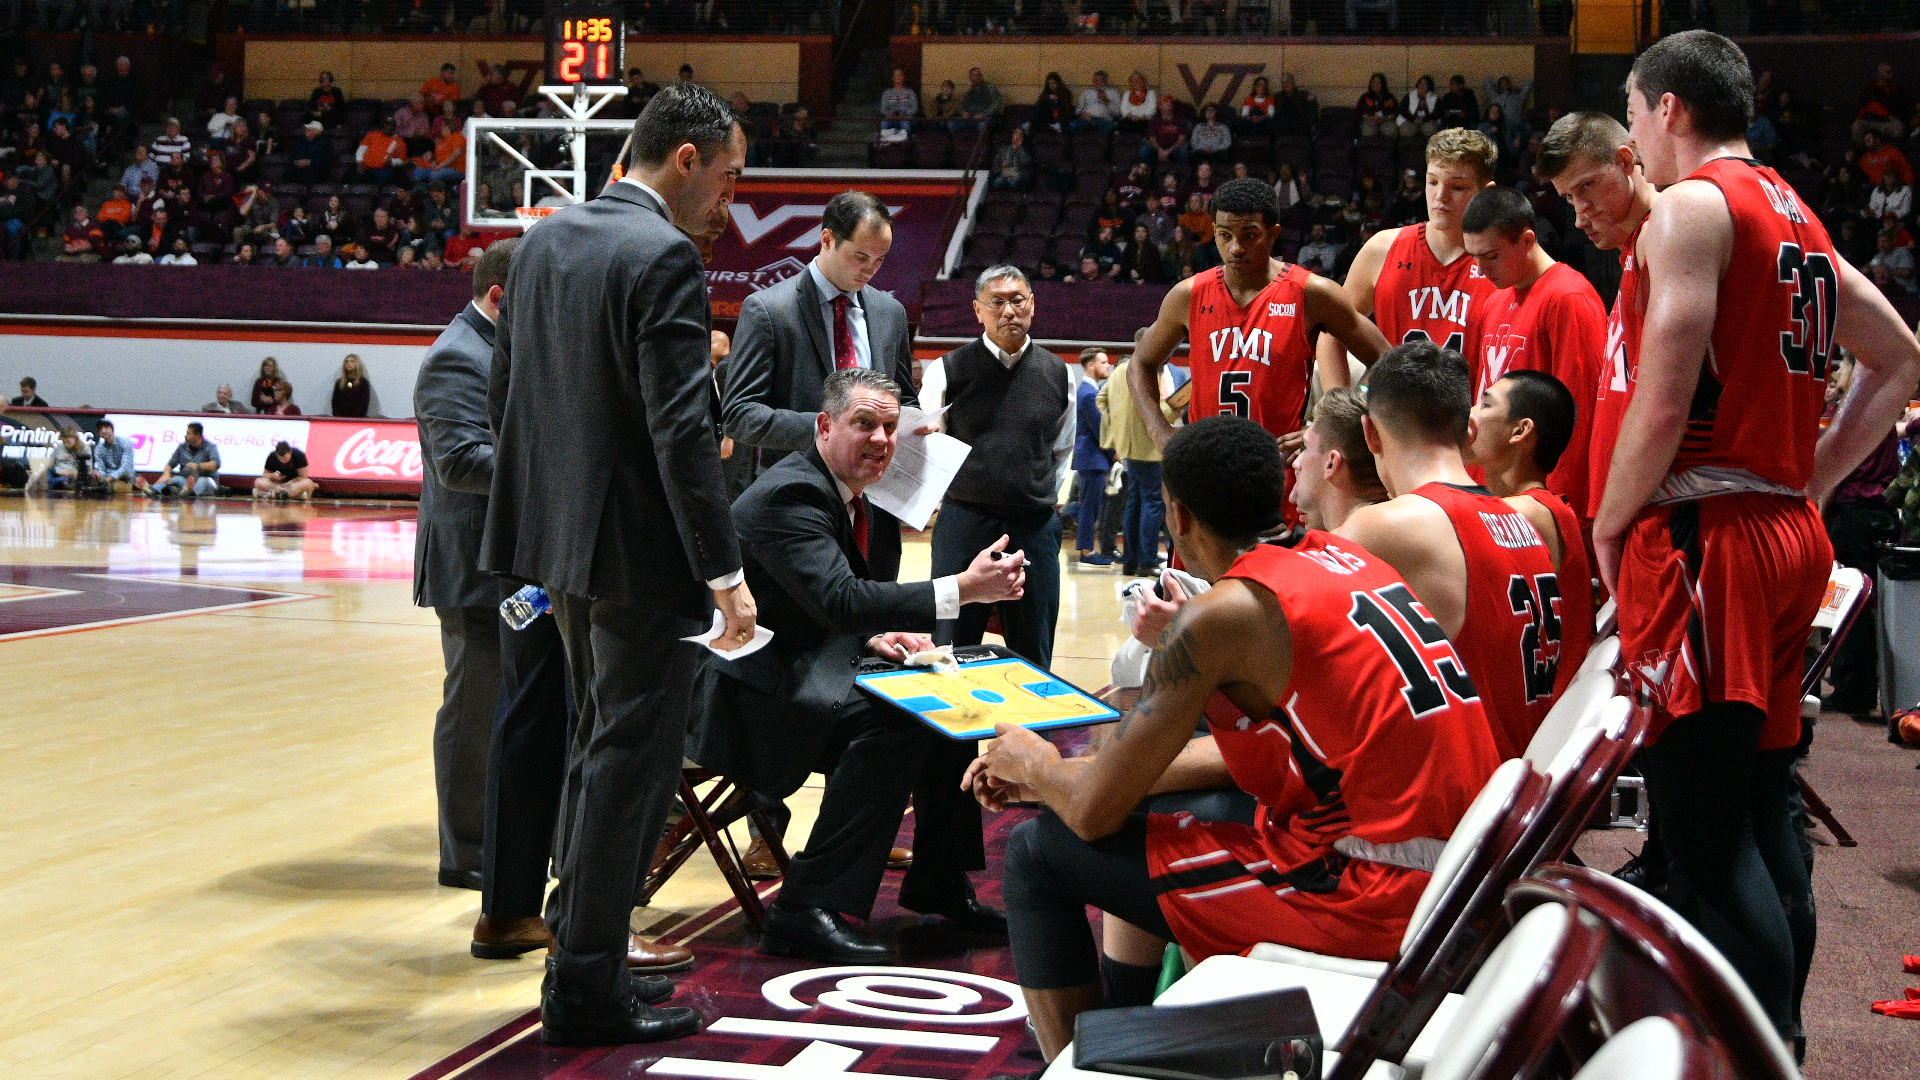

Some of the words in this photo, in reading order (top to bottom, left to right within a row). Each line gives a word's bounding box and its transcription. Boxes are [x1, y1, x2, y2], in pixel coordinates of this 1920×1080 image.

[563, 18, 613, 42] 11:35
[560, 41, 608, 82] 21
[1177, 63, 1266, 105] VT
[727, 203, 905, 249] VT
[703, 270, 768, 282] FIRST
[1268, 302, 1296, 317] SOCON
[1408, 286, 1471, 327] VMI
[1777, 241, 1839, 382] 30
[1209, 326, 1273, 367] VMI
[1218, 370, 1252, 420] 5
[162, 429, 265, 447] BLSBURG
[1346, 582, 1481, 720] 15
[1507, 572, 1563, 706] 25
